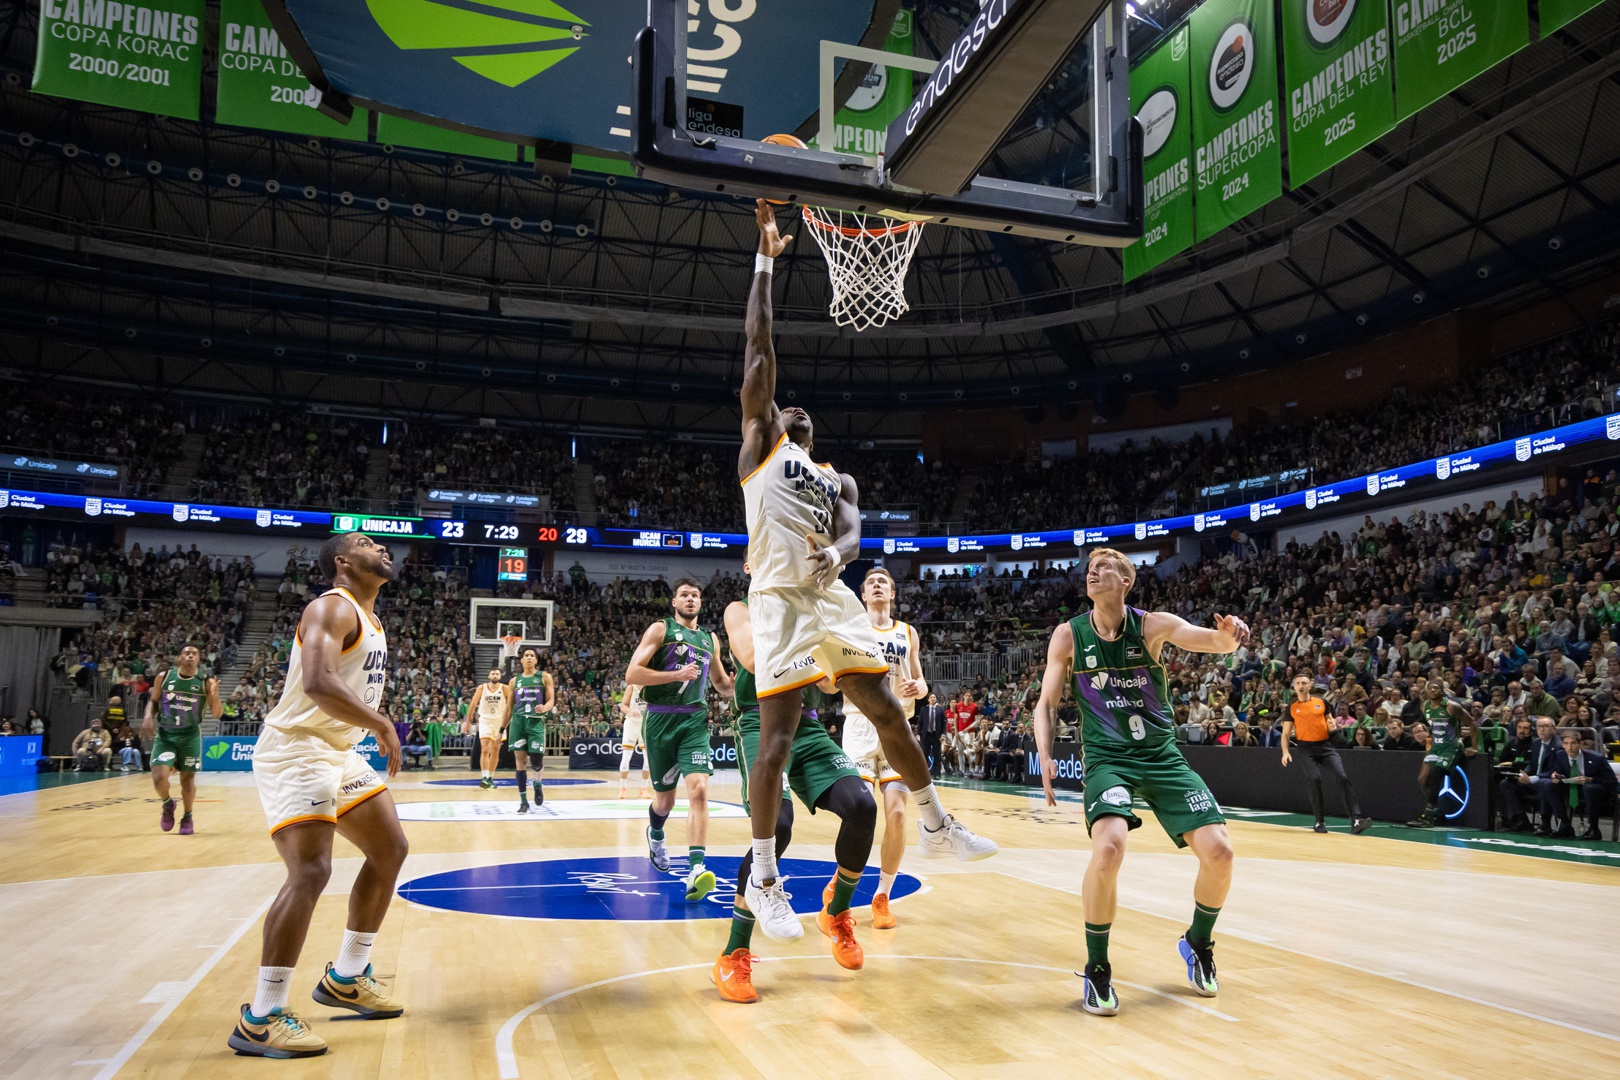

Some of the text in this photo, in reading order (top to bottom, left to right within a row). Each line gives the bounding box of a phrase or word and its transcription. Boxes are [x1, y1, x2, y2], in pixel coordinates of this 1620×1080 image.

[45, 0, 199, 45] CAMPEONES
[1438, 5, 1472, 38] BCL
[51, 22, 190, 61] COPA KORAC
[1437, 23, 1477, 65] 2025
[69, 52, 170, 86] 2000/2001
[221, 52, 276, 74] COPA
[1291, 28, 1387, 119] CAMPEONES
[270, 85, 306, 105] 200
[1293, 58, 1387, 133] COPA DEL REY
[688, 107, 713, 122] liga
[688, 121, 741, 138] endesa
[1196, 99, 1273, 174] CAMPEONES
[1324, 111, 1356, 146] 2025
[1198, 128, 1276, 191] SUPERCOPA
[1222, 172, 1249, 202] 2024
[1145, 221, 1168, 247] 2024
[1533, 436, 1556, 447] Ciudad
[1533, 442, 1565, 455] de Málaga
[1452, 456, 1472, 466] Ciudad
[1460, 462, 1480, 473] Málaga
[1380, 474, 1398, 484] Ciudad
[362, 519, 588, 544] UNICAJA 23 7:29 20 29
[632, 538, 661, 547] MURCIA
[640, 531, 661, 540] UCAM
[505, 559, 524, 573] 19
[1110, 676, 1148, 688] Unicaja
[175, 716, 180, 726] 1
[1128, 714, 1146, 740] 9
[1188, 800, 1212, 812] laga
